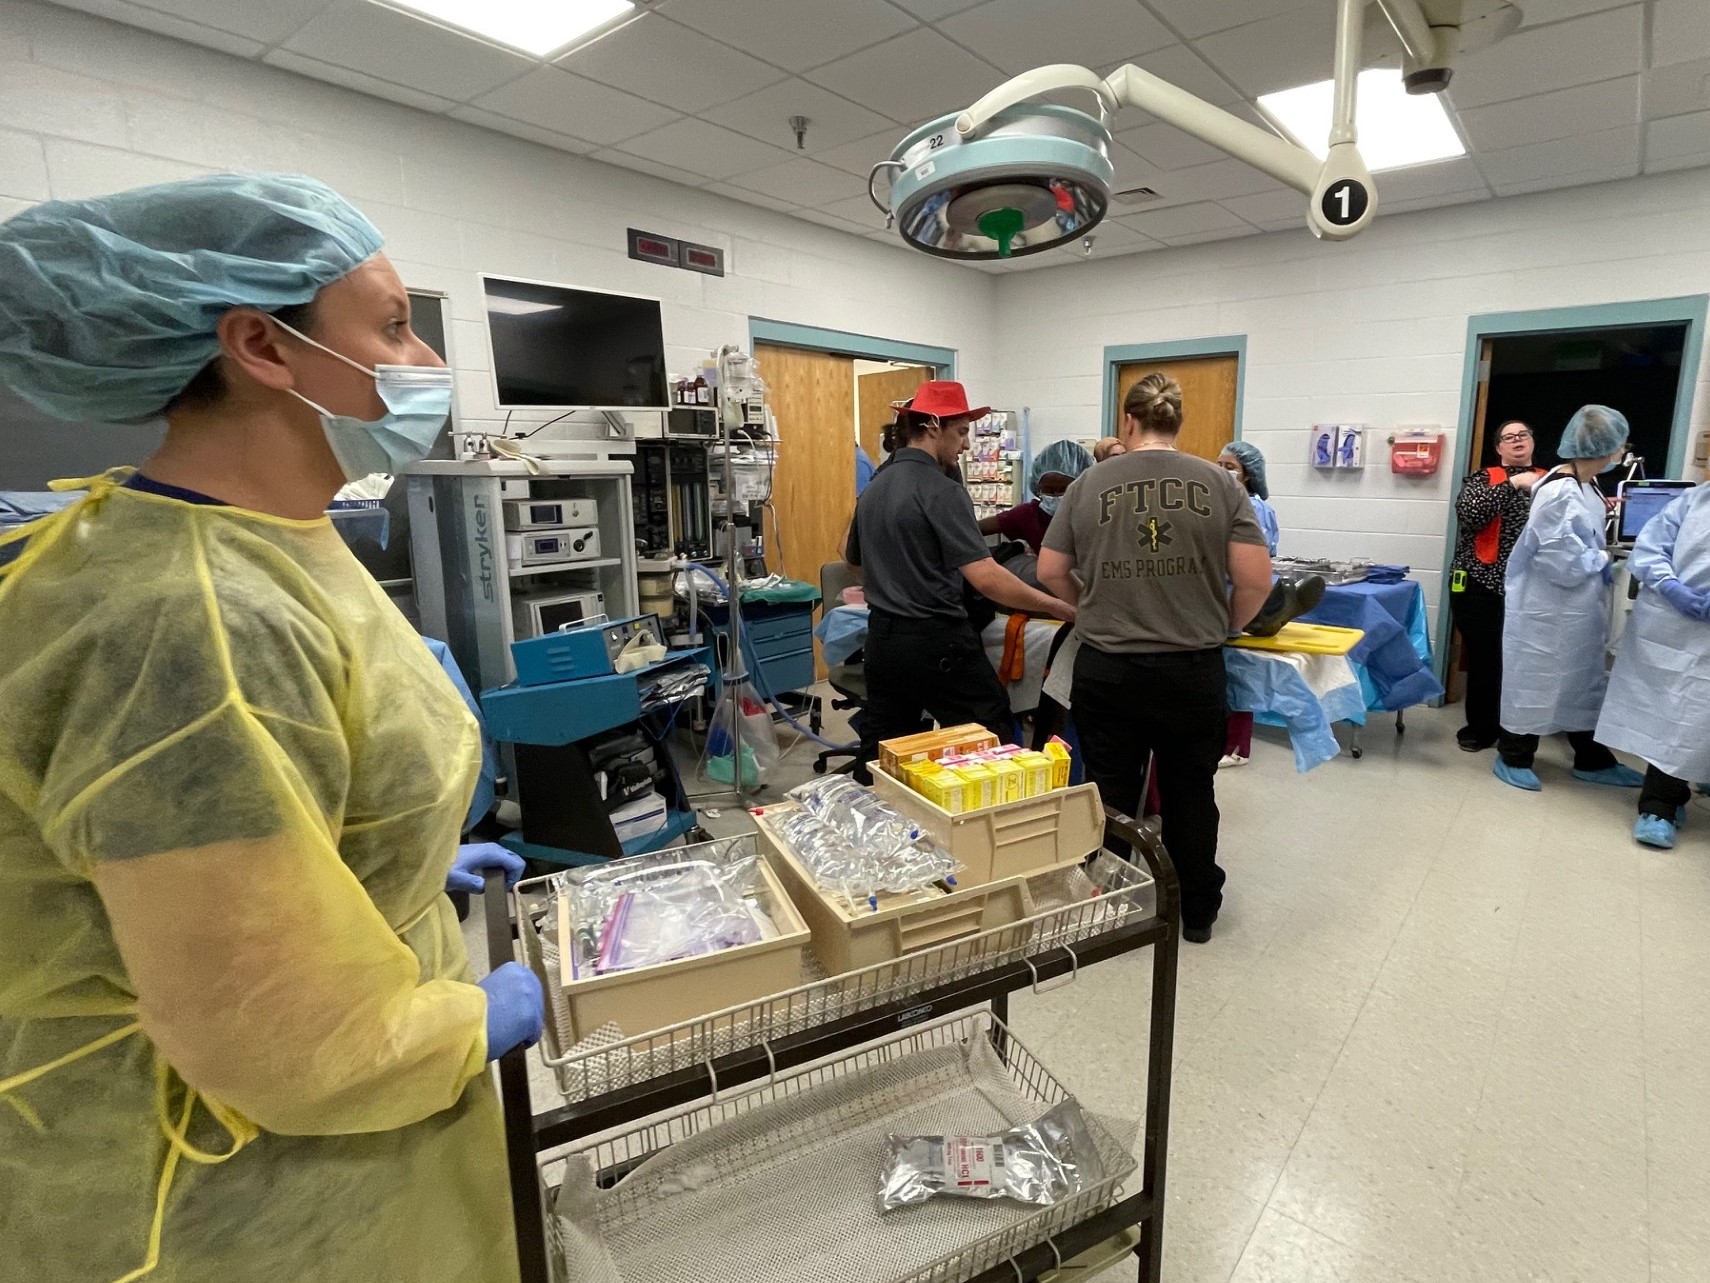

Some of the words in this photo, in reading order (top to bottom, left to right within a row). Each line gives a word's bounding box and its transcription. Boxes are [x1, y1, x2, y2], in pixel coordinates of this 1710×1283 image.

[930, 134, 944, 150] 22
[1334, 186, 1350, 218] 1
[1098, 478, 1211, 526] FTCC
[474, 495, 493, 602] stryker
[1101, 560, 1132, 579] EMS
